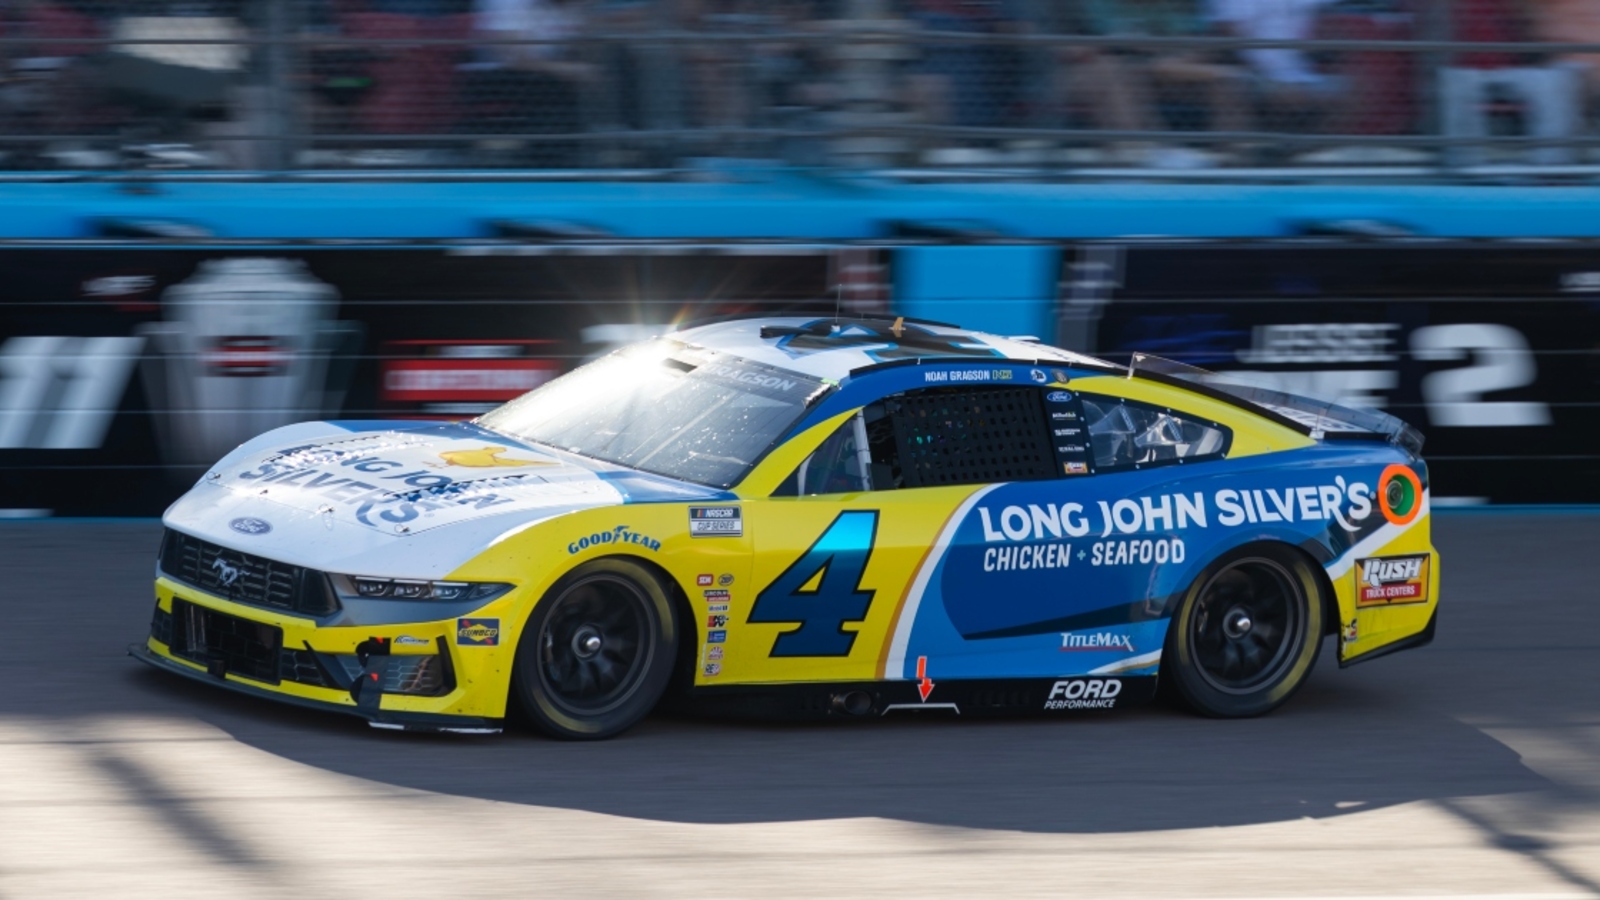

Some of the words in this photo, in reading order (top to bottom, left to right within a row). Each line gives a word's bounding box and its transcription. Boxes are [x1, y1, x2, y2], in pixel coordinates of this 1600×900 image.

[925, 372, 948, 382] NOAH
[950, 370, 990, 381] GRAGSON
[1408, 323, 1554, 426] 2
[705, 508, 734, 518] NASCAR
[978, 503, 1089, 542] LONG
[1101, 493, 1208, 538] JOHN
[1214, 475, 1371, 532] SILVER'S
[697, 521, 711, 531] CUP
[712, 520, 735, 531] SERIES
[983, 544, 1071, 572] CHICKEN
[1091, 539, 1186, 566] SEAFOOD
[1363, 558, 1423, 588] RUSH
[746, 509, 880, 658] 4
[1366, 588, 1385, 599] TRUCK
[1387, 585, 1415, 597] CENTERS
[459, 627, 497, 637] SUNOCO
[1048, 679, 1122, 700] FORD
[1044, 699, 1116, 710] PERFORMANCE
